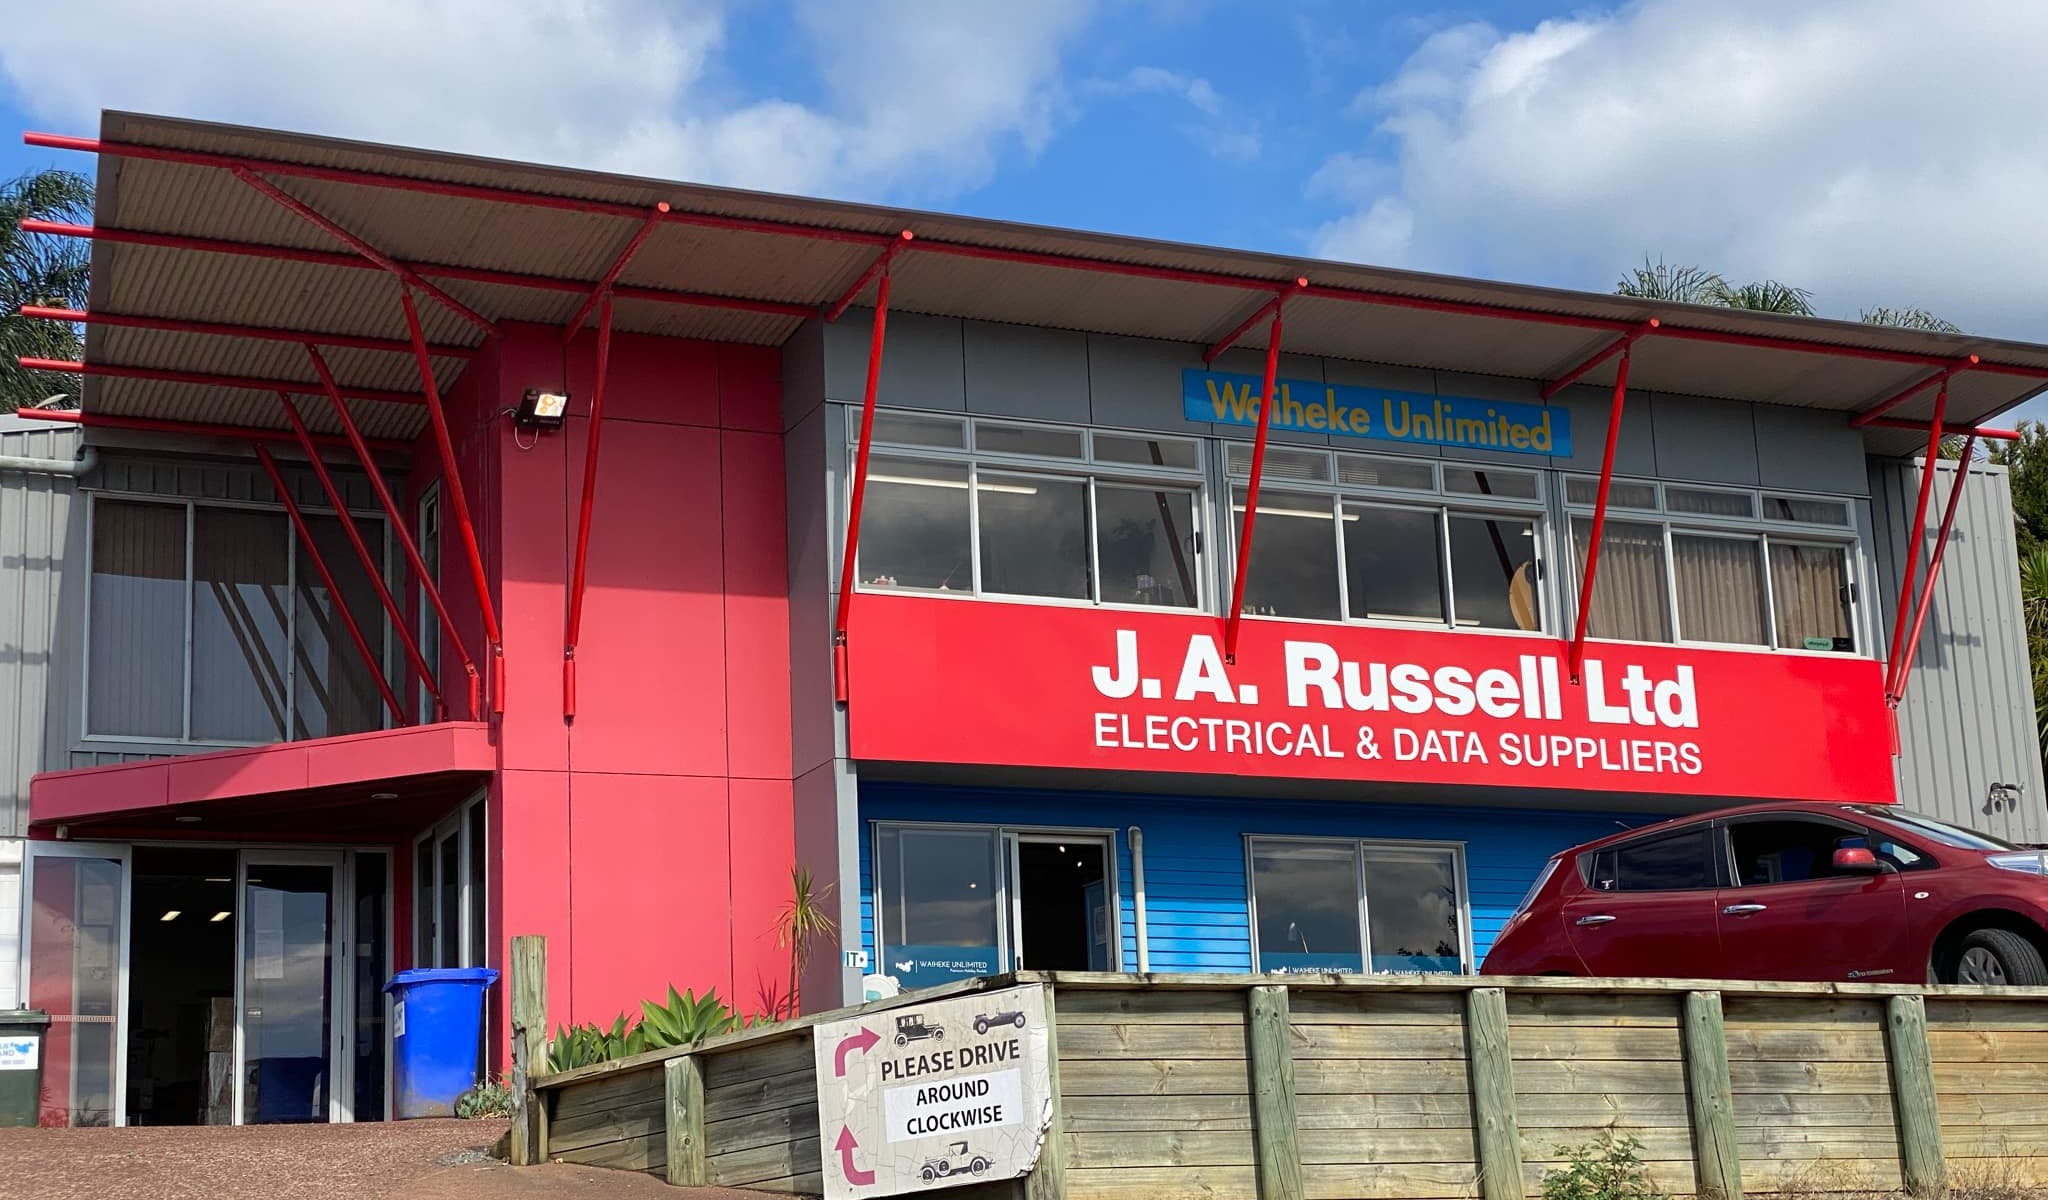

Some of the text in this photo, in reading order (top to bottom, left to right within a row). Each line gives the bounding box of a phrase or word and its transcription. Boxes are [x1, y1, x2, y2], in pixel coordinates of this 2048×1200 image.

[1206, 379, 1553, 451] Waiheke Unlimited
[1091, 630, 1699, 728] J. A. Russell Ltd
[1094, 712, 1703, 775] ELECTRICAL & DATA SUPPLIERS
[919, 960, 988, 969] WAIHEKE UNLIMITED
[881, 1038, 1020, 1081] PLEASE DRIVE
[916, 1079, 989, 1106] AROUND
[906, 1105, 1003, 1135] CLOCKWISE
